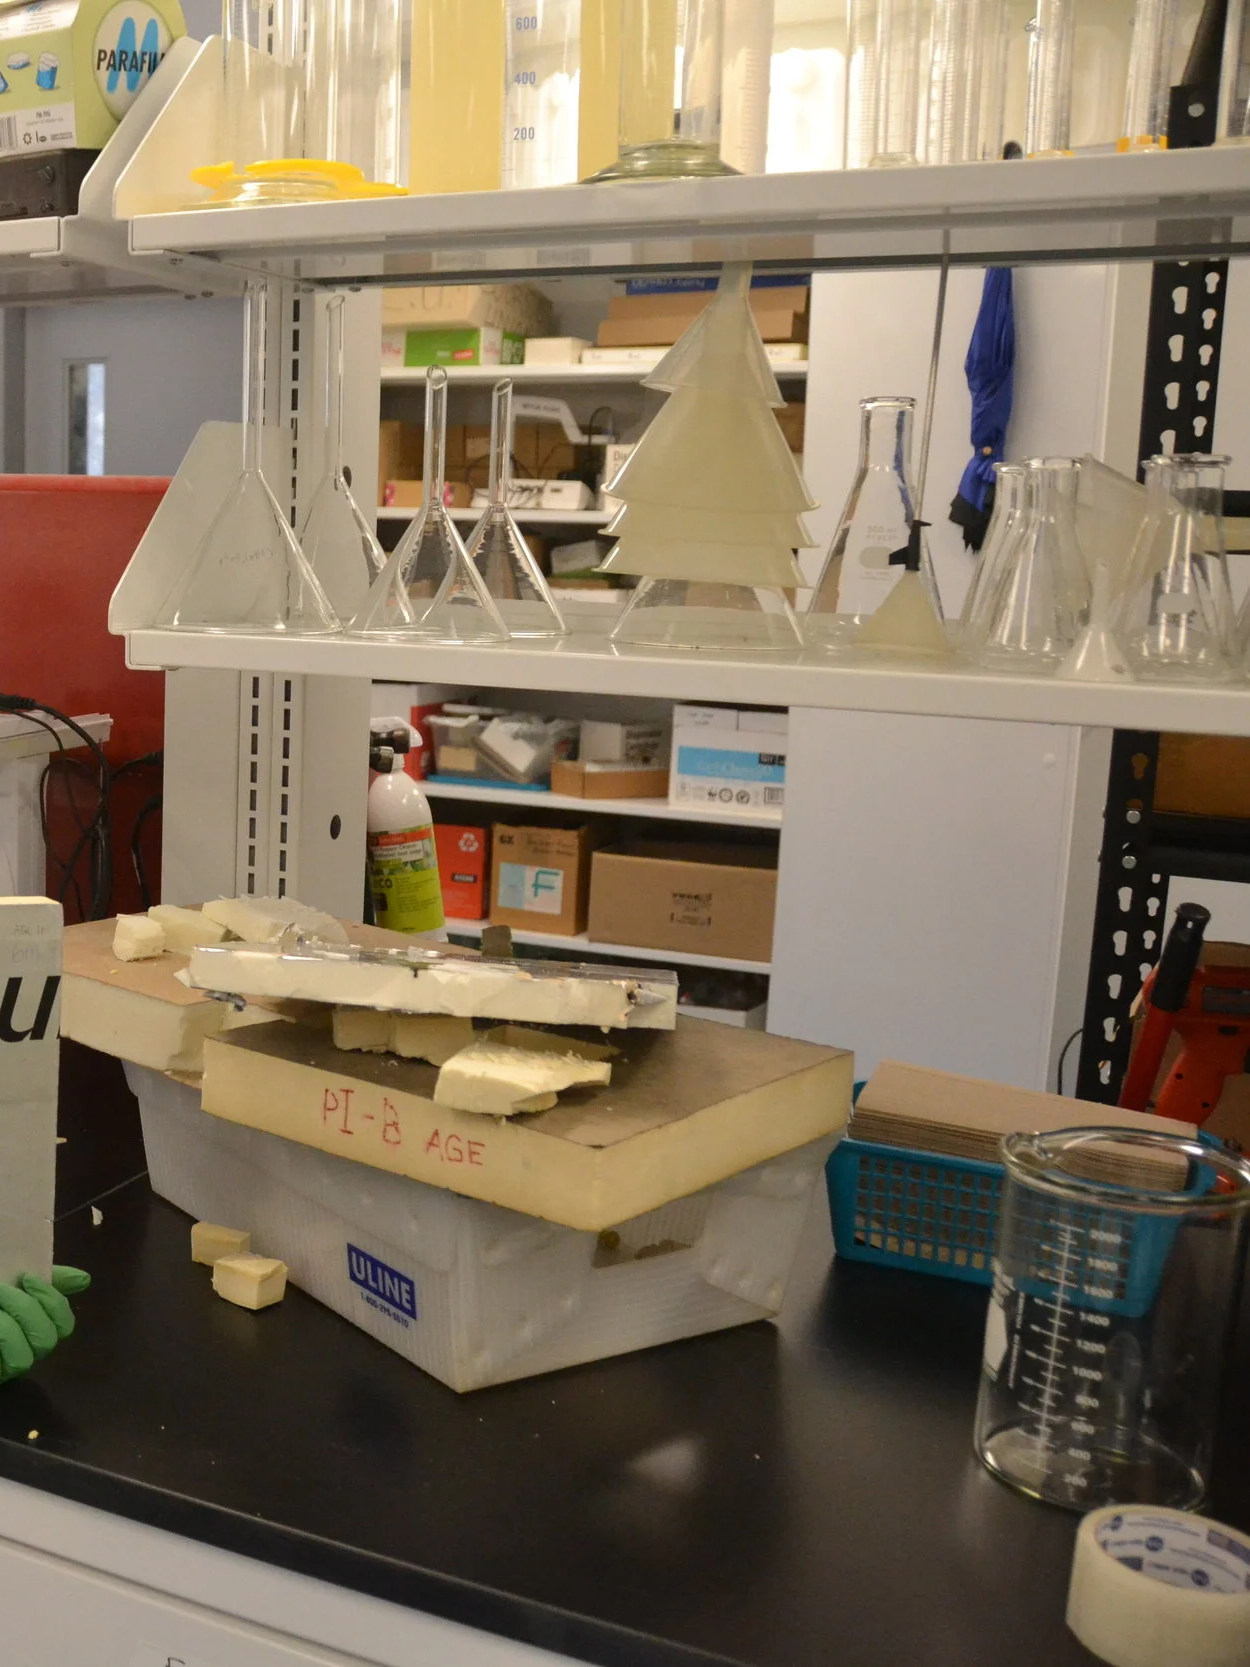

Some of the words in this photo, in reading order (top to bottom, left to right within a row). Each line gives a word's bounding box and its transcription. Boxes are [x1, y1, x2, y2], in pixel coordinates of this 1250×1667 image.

[516, 16, 537, 30] 600
[514, 71, 536, 85] 400
[513, 127, 535, 141] 200
[531, 869, 561, 898] F
[425, 1127, 486, 1166] AGE
[350, 1250, 413, 1312] ULINE
[1079, 1311, 1110, 1327] 1400
[1075, 1338, 1107, 1354] 1200
[1072, 1365, 1103, 1381] 1000
